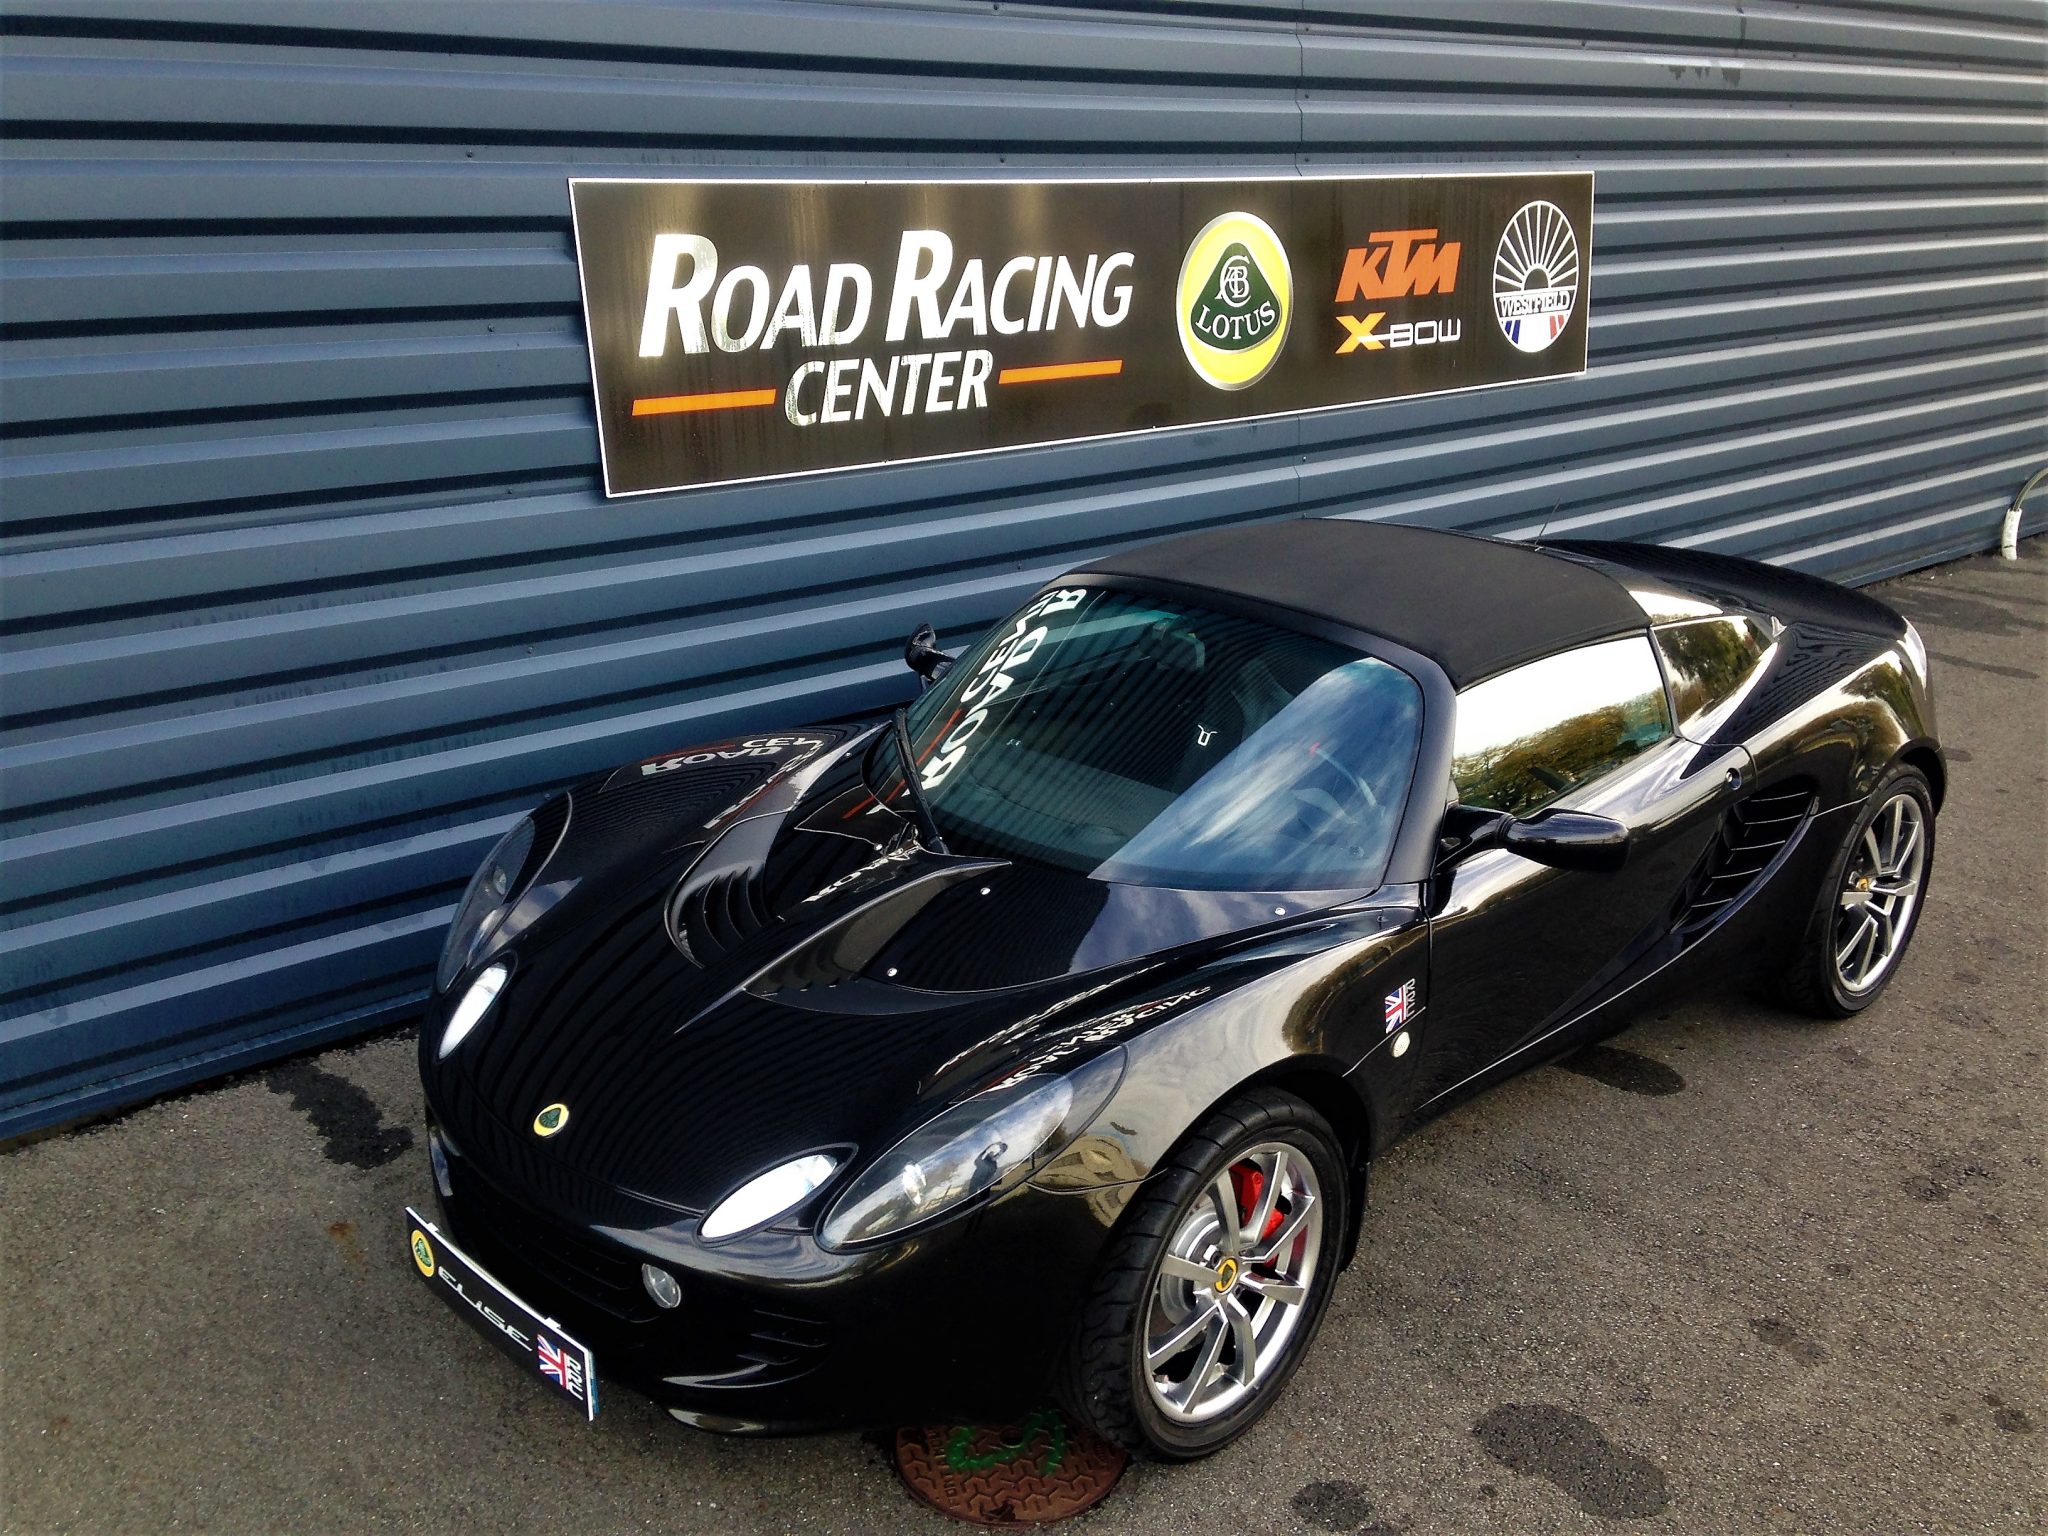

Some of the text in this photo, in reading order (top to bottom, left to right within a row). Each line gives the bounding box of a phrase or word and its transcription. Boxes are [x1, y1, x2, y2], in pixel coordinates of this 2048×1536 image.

[638, 229, 1135, 357] ROAD RACING
[1334, 228, 1461, 303] KTM
[1194, 299, 1276, 340] LOTUS
[1335, 311, 1462, 355] X-BOW
[1499, 289, 1571, 318] WESTFIELD
[783, 348, 994, 427] CENTER
[437, 1265, 533, 1352] ELISE
